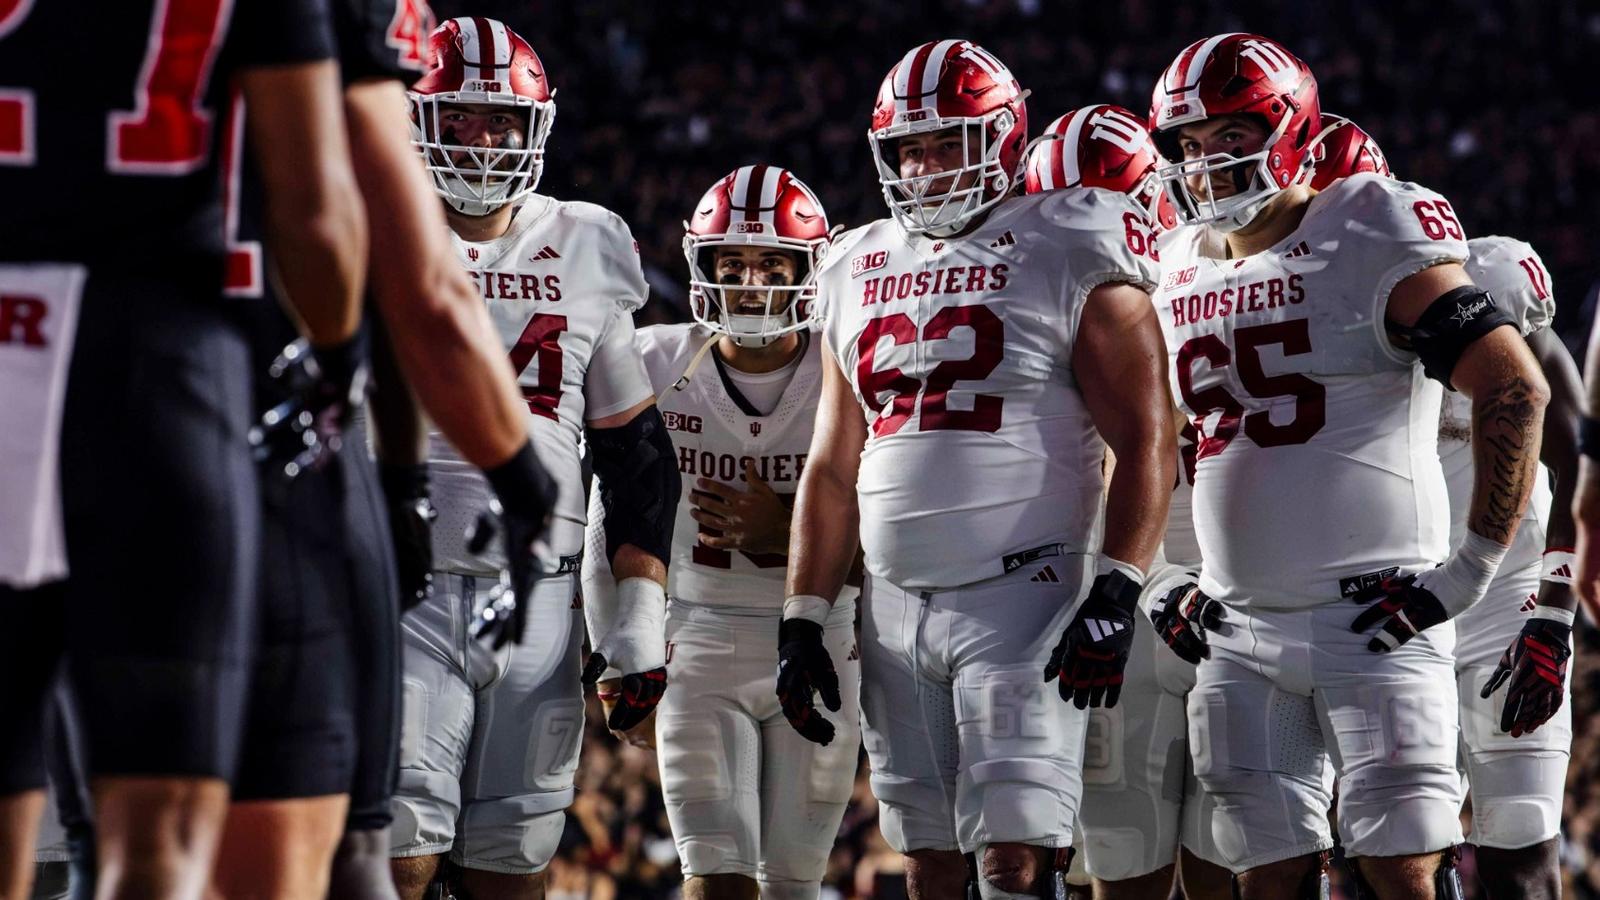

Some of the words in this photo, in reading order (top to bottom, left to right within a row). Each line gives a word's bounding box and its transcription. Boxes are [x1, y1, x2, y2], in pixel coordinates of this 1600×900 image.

[1413, 199, 1463, 241] 65
[862, 263, 1009, 307] HOOSIERS
[1171, 274, 1305, 327] HOOSIERS
[1518, 256, 1549, 300] 11
[0, 293, 49, 350] R
[857, 304, 1005, 438] 62
[1176, 318, 1326, 460] 65
[547, 717, 576, 775] 7
